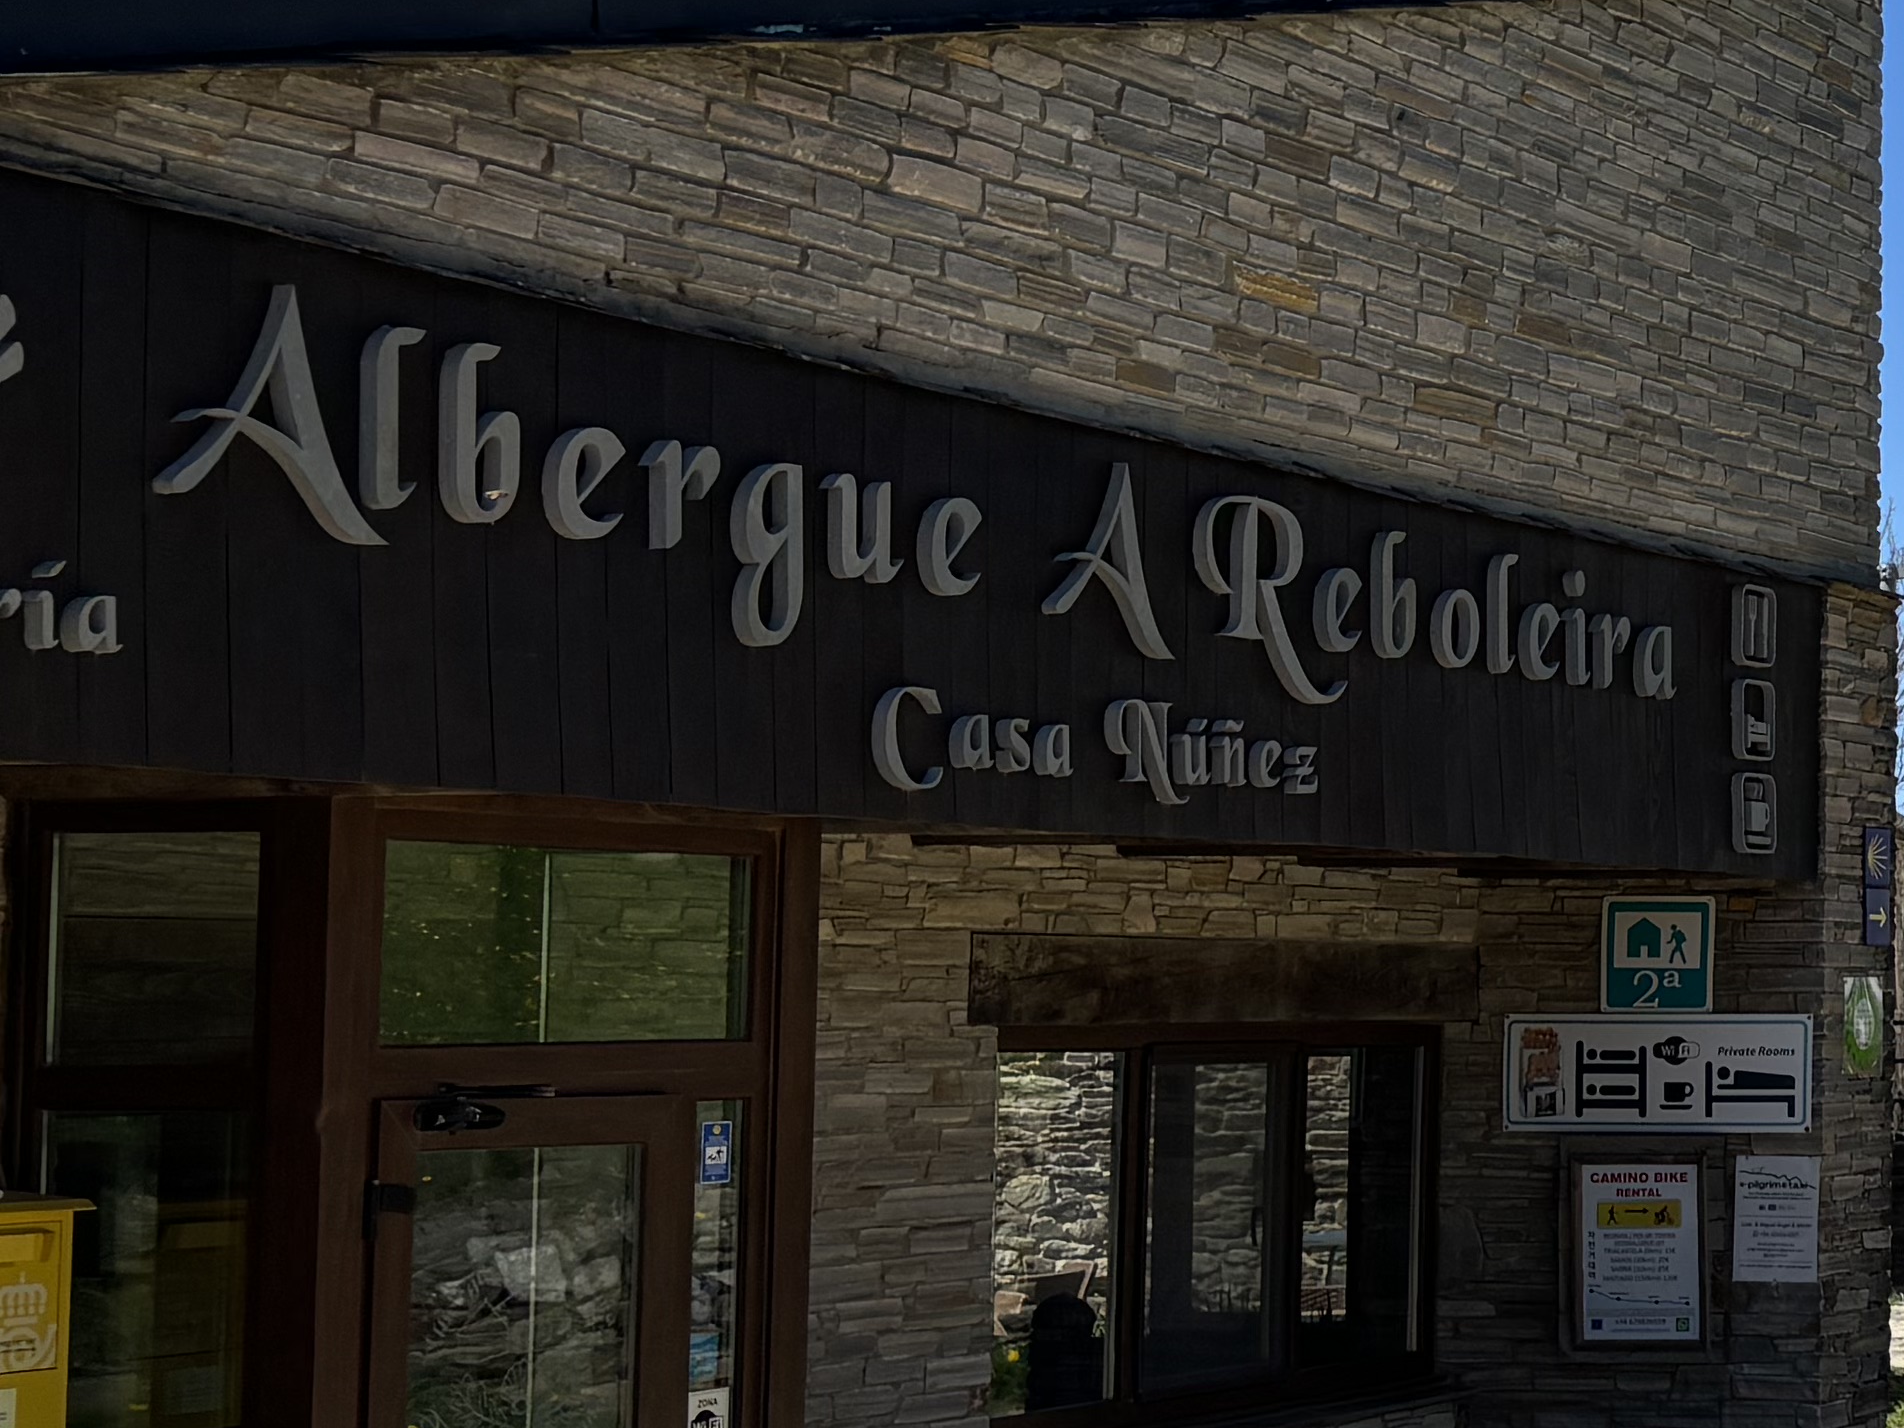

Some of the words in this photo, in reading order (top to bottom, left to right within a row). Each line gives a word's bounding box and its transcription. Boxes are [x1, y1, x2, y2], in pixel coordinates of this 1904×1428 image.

[152, 284, 983, 647] Albergue
[1042, 463, 1173, 660] A
[1193, 495, 1679, 705] Reboleira
[871, 686, 1073, 792] Casa
[1105, 698, 1321, 805] Núñez
[1717, 1046, 1757, 1057] Private
[1758, 1046, 1796, 1057] Rooms
[1590, 1172, 1649, 1183] CAMINO
[1654, 1172, 1688, 1183] BIKE
[1616, 1188, 1662, 1197] RENTAL
[697, 1397, 718, 1409] ZONA
